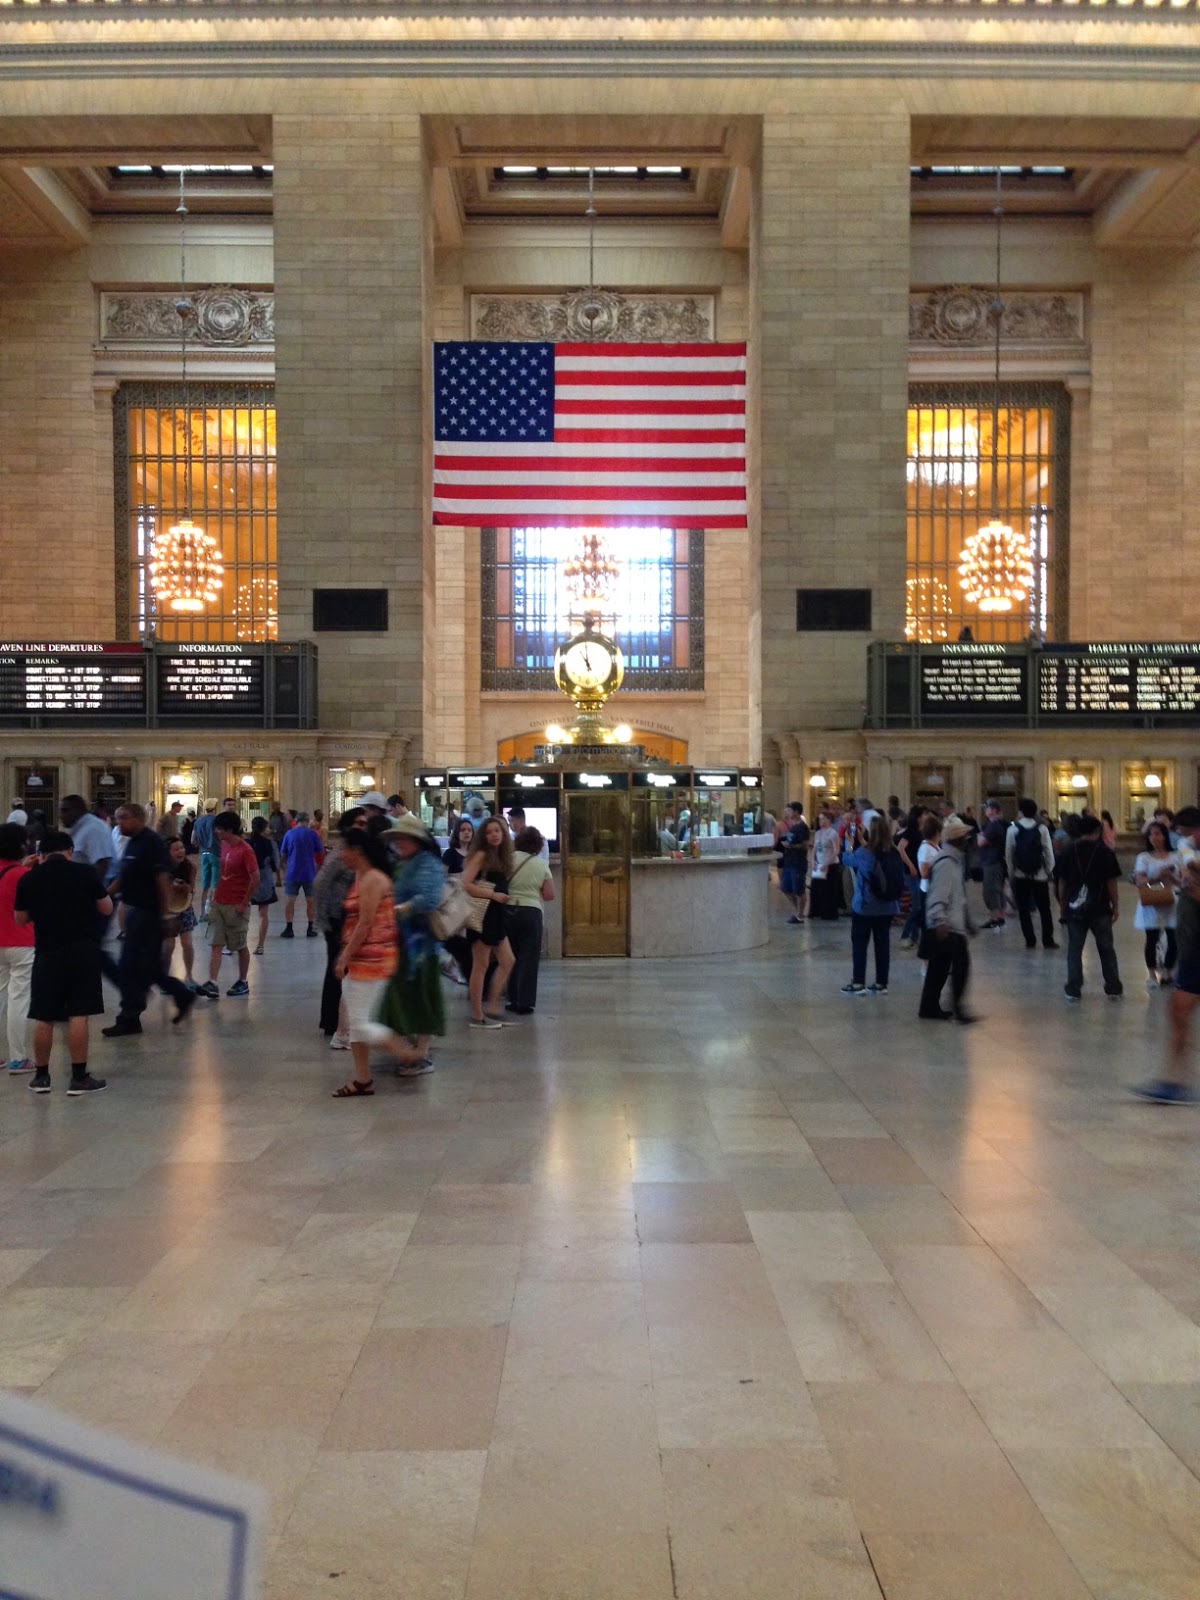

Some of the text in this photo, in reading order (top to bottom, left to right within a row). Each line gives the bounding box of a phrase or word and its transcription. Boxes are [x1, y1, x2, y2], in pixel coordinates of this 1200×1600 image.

[25, 644, 46, 652] LINE
[48, 644, 104, 652] DEPARTURES
[942, 644, 1005, 653] INFORMATION
[1088, 643, 1127, 653] HARLEM
[1129, 643, 1149, 653] LINE
